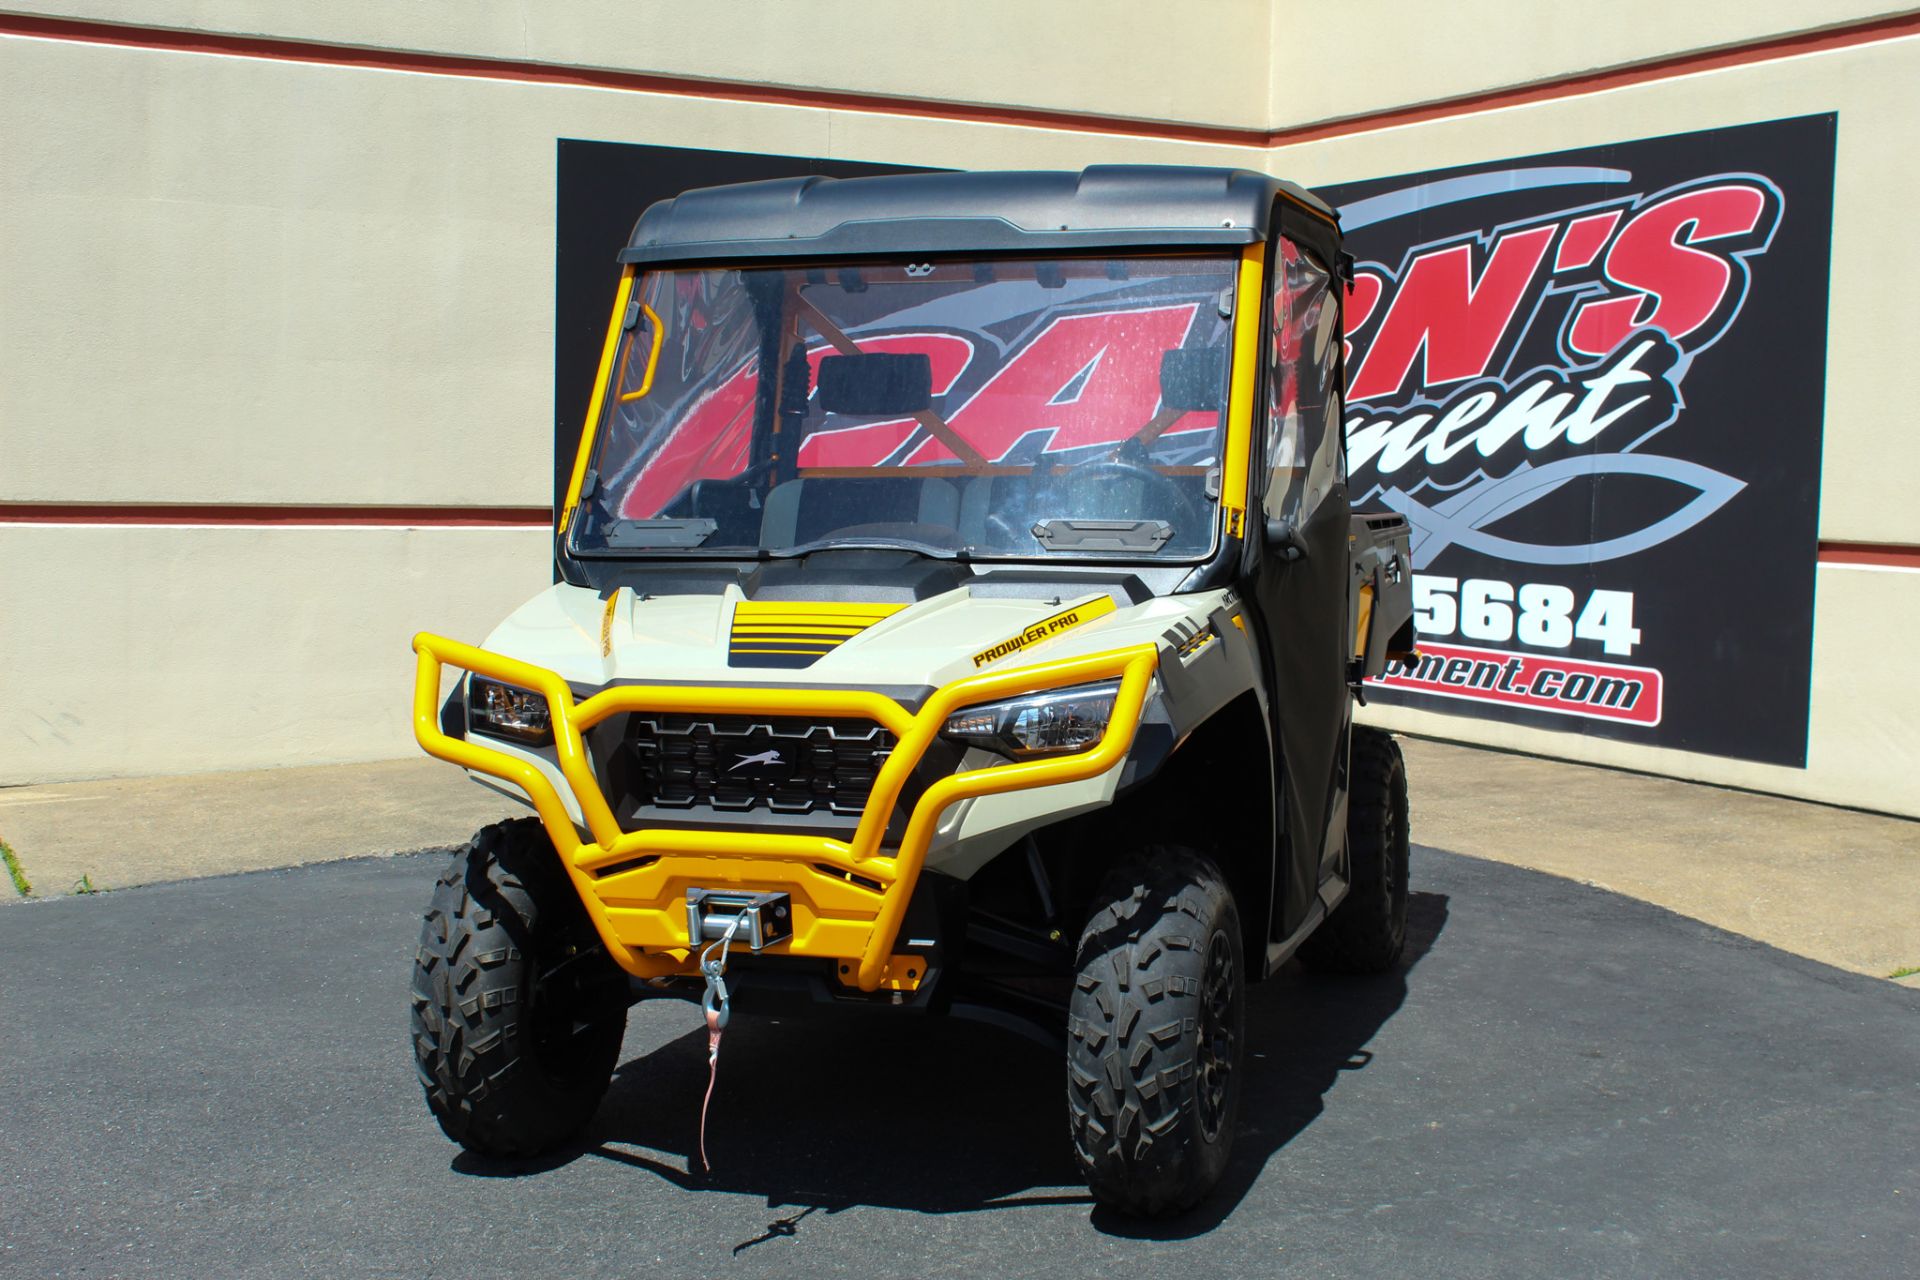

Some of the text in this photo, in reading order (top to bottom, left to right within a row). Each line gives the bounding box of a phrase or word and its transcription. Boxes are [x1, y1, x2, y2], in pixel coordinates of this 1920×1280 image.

[1344, 185, 1766, 403] N'S
[973, 612, 1079, 668] PROWLER PRO
[1411, 574, 1642, 657] 5684
